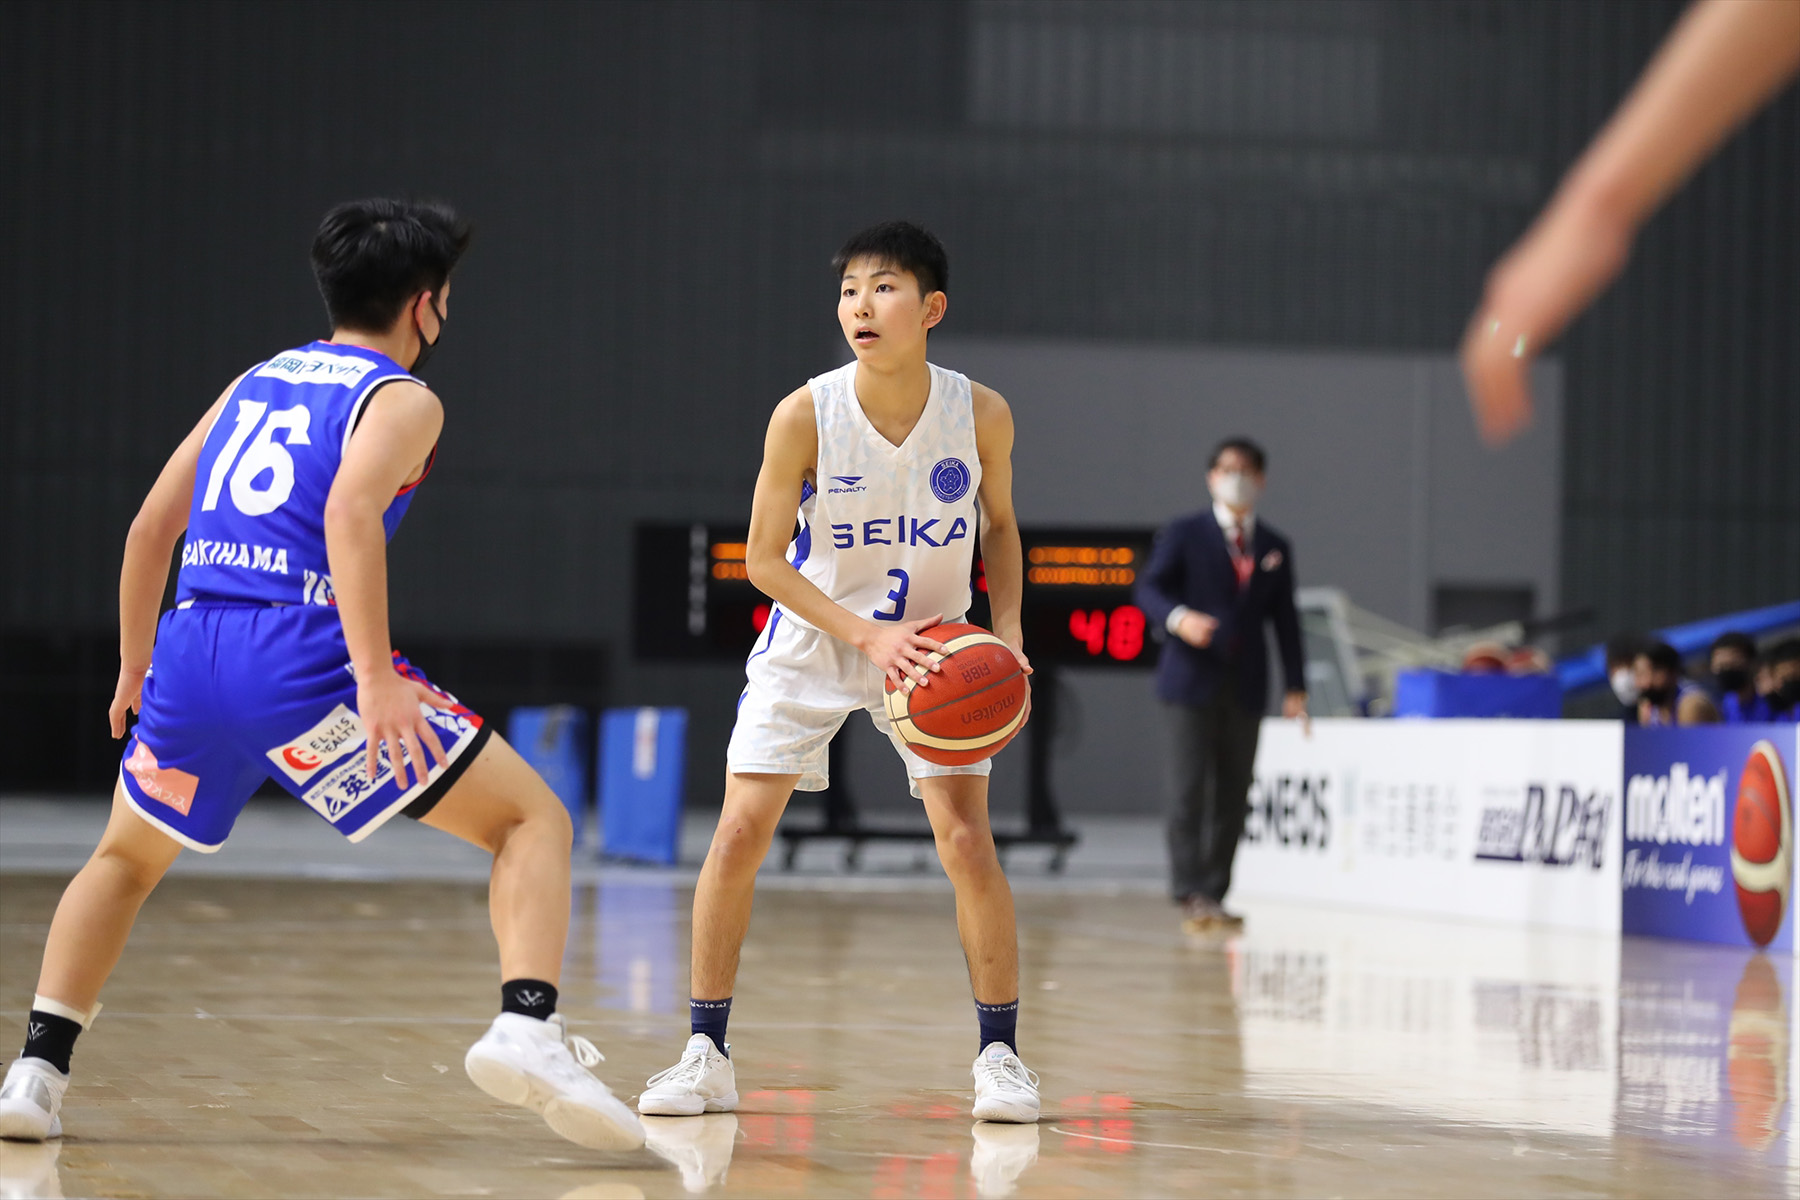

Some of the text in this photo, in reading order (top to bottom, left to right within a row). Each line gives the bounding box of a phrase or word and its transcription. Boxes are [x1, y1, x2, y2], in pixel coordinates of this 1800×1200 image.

[202, 399, 312, 517] 16
[941, 460, 959, 468] SEIKA
[828, 486, 867, 495] PENALTY
[831, 515, 968, 549] SEIKA
[182, 538, 289, 575] SAKIHAMA
[873, 568, 910, 621] 3
[1068, 605, 1146, 661] 48
[961, 662, 992, 684] FIBA
[960, 693, 1016, 725] molten
[310, 716, 351, 749] ELVIS
[1625, 761, 1726, 847] molten
